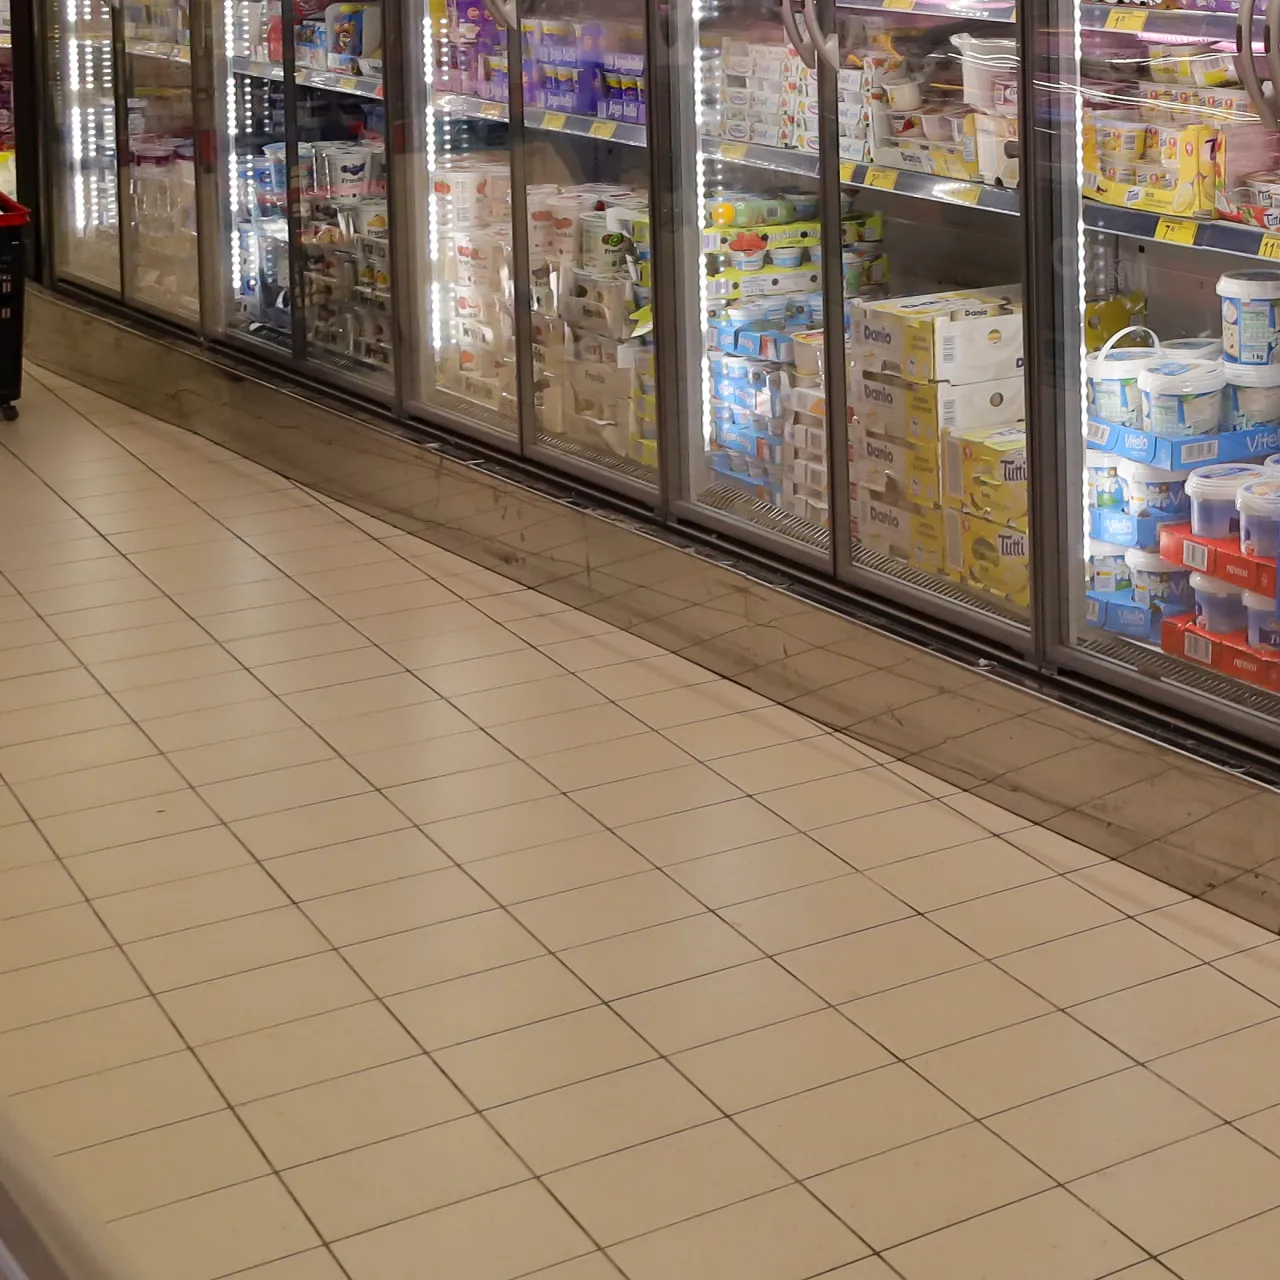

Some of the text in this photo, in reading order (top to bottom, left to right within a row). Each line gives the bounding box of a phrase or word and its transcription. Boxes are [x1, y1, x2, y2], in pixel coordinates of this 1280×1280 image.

[864, 324, 891, 346] Danio
[864, 386, 893, 406] Danio
[1000, 459, 1027, 482] Tutti
[998, 533, 1025, 556] Tutti
